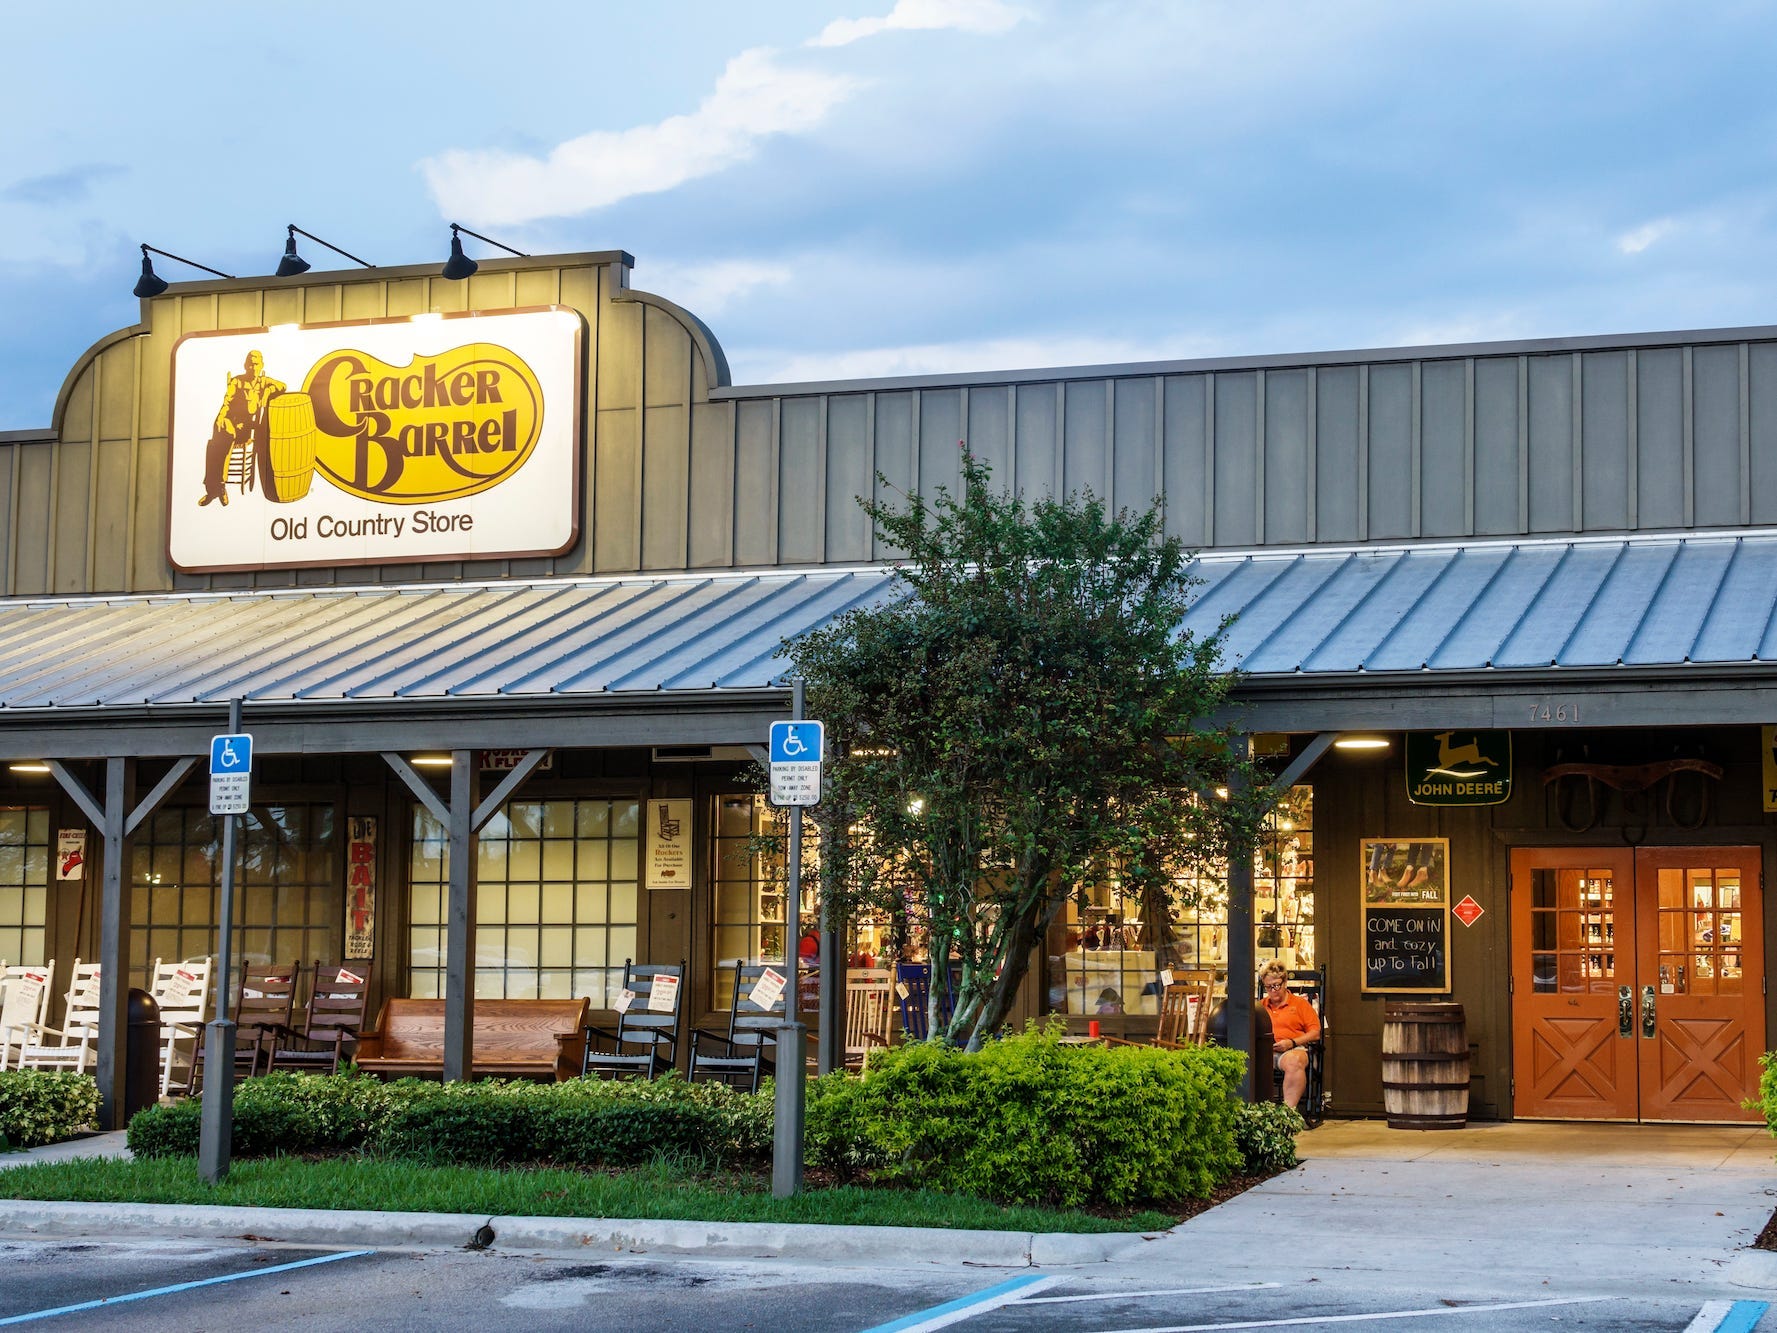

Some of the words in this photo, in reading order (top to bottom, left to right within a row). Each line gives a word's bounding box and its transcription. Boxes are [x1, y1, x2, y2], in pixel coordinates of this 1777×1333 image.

[270, 516, 308, 541] Old
[316, 513, 405, 539] Country
[412, 510, 474, 534] Store
[1529, 703, 1581, 722] 7461
[1414, 783, 1453, 796] JOHN
[1456, 782, 1503, 795] DEERE
[351, 842, 373, 931] BAIT
[1421, 890, 1438, 900] FALL
[1368, 918, 1403, 933] COME
[1406, 917, 1424, 933] ON
[1374, 937, 1398, 950] and
[1402, 940, 1436, 954] cozy
[1389, 956, 1405, 970] To
[1410, 955, 1436, 970] Fall
